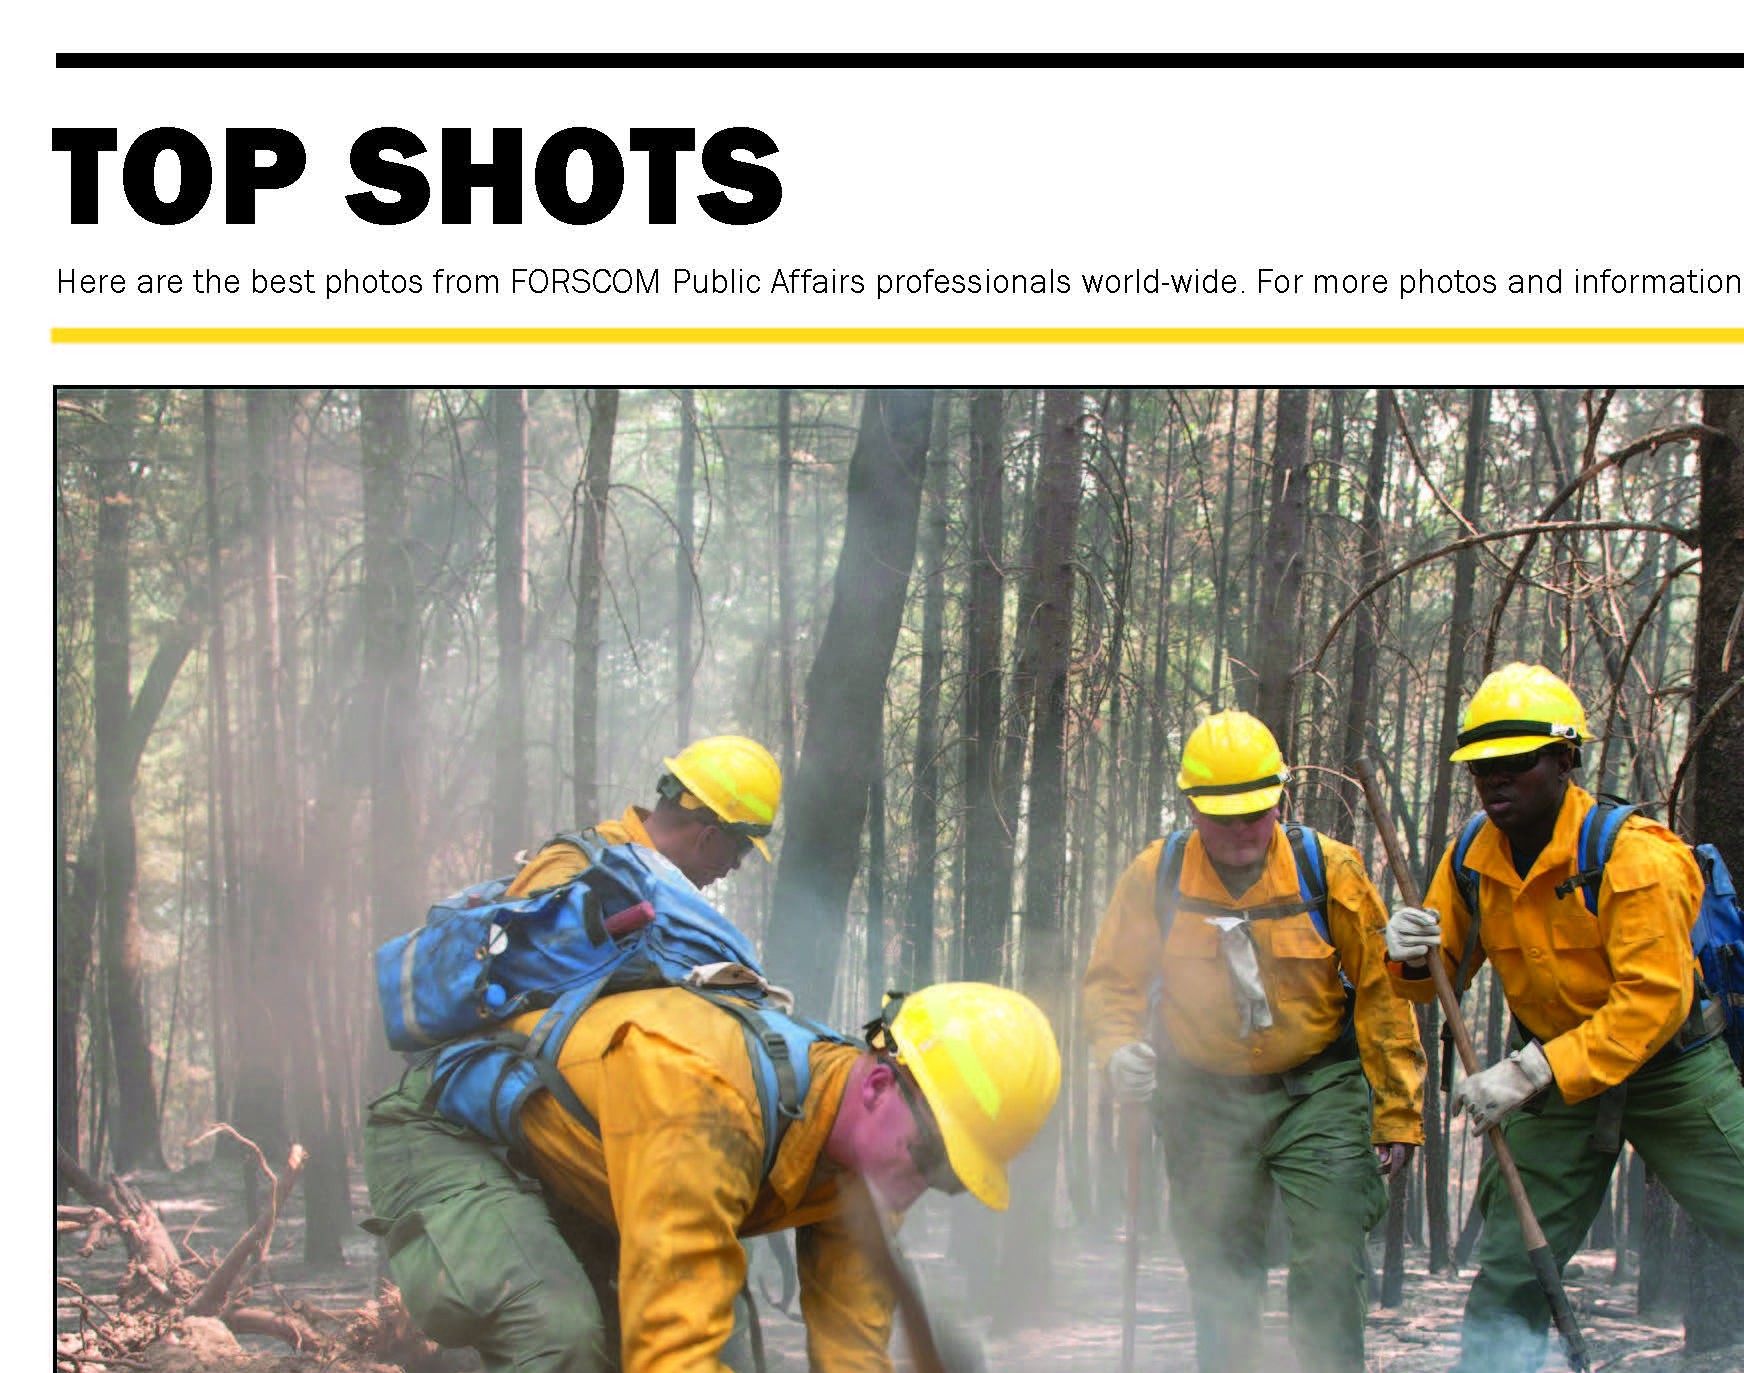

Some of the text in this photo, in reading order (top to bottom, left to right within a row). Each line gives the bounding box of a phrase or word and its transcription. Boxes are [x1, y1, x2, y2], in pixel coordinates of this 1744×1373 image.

[51, 126, 783, 226] TOP SHOTS
[58, 268, 126, 294] Here
[137, 273, 183, 294] are
[192, 268, 240, 295] the
[252, 268, 316, 294] best
[326, 268, 423, 300] photos
[432, 268, 499, 295] from
[512, 268, 659, 294] FORSCOM
[674, 268, 761, 294] Public
[770, 268, 865, 294] Affairs
[877, 268, 1071, 300] professionals
[1081, 268, 1245, 294] world-wide.
[1258, 268, 1304, 295] For
[1314, 274, 1388, 295] more
[1400, 268, 1497, 300] photos
[1508, 268, 1562, 295] and
